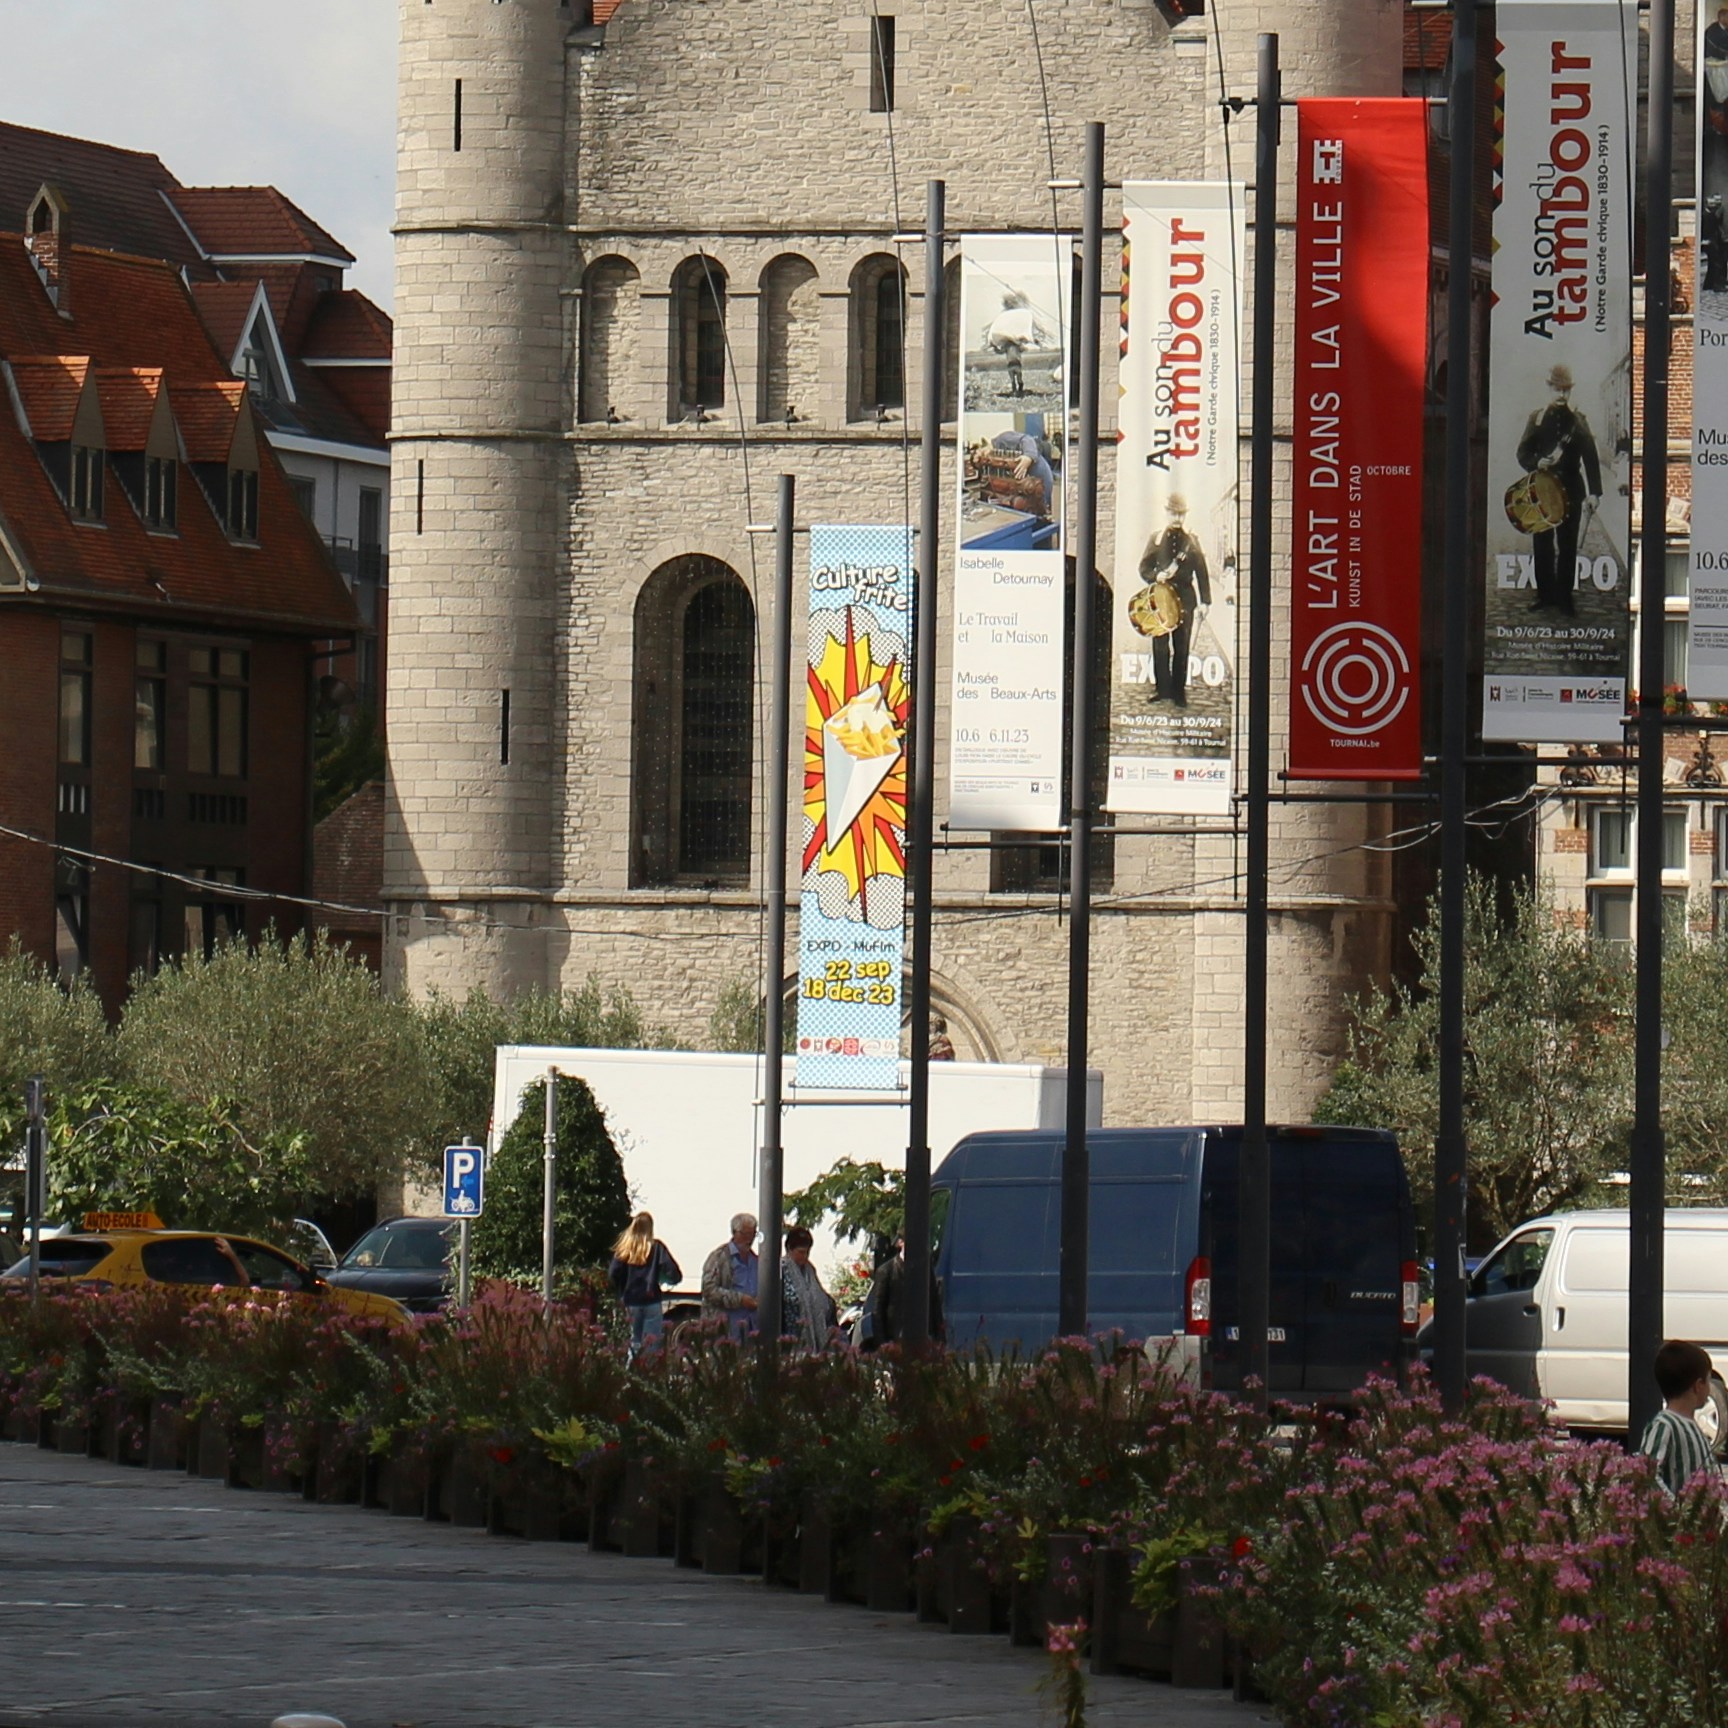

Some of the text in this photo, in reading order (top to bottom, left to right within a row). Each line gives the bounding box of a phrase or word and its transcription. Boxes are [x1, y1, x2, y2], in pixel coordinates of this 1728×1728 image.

[1539, 41, 1592, 326] tambour
[1596, 198, 1610, 243] civique
[1524, 162, 1555, 340] Au son du
[1595, 245, 1607, 285] Garde
[1160, 218, 1205, 460] tambour
[1208, 351, 1221, 392] civique
[1146, 321, 1173, 471] Au son du
[1308, 201, 1342, 609] L'ART DANS LA VILLE
[1208, 395, 1218, 426] Garde
[1697, 449, 1728, 466] des
[1366, 465, 1412, 476] OCTOBRE
[1349, 465, 1362, 608] KUNST IN DE STAD
[960, 557, 1004, 570] Isabelle
[812, 562, 899, 591] Culture
[993, 572, 1054, 587] Detournay
[854, 578, 909, 611] frite
[959, 612, 1018, 626] Le Travail
[958, 630, 1049, 644] et la Maison
[1497, 627, 1615, 640] Du 9/6/23 au 30/9/24
[957, 672, 999, 684] Musée
[957, 687, 1057, 700] des Beaux-Arts
[1576, 687, 1621, 700] MUSÉE
[1120, 715, 1222, 728] Du 9/6/23 au 30/9/24
[956, 728, 1030, 743] 10.6 6.11.23
[1330, 739, 1380, 748] TOURNAI.be
[807, 940, 842, 952] EXPO
[825, 959, 892, 982] 22 sep
[802, 978, 895, 1006] 18 dec 23
[453, 1152, 474, 1188] P
